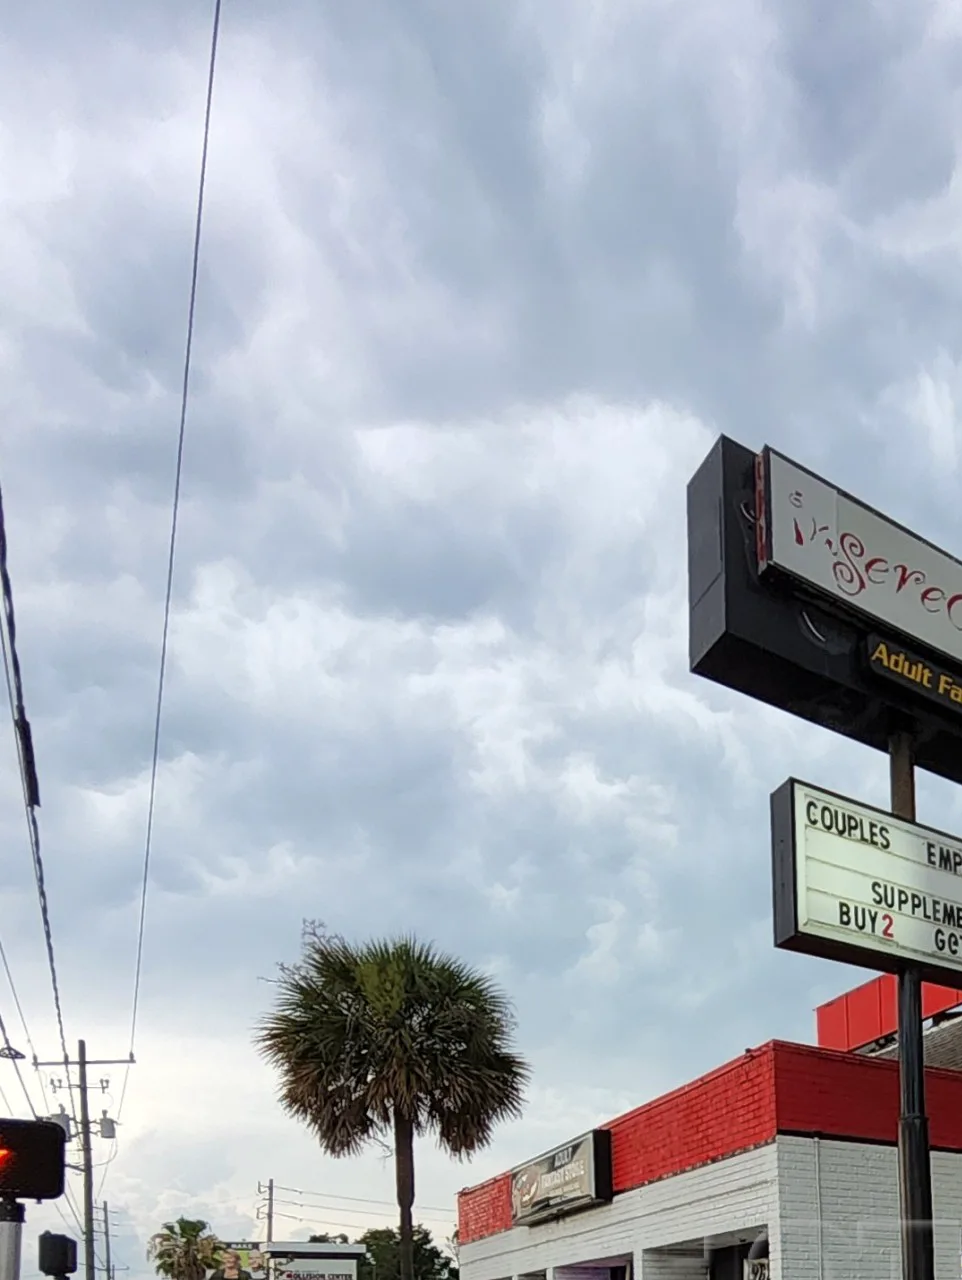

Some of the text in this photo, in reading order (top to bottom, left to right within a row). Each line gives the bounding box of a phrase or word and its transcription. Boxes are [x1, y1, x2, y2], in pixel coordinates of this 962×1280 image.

[871, 643, 932, 688] Adult
[806, 800, 891, 850] COUPLES
[838, 901, 879, 934] BUY
[881, 913, 894, 939] 2
